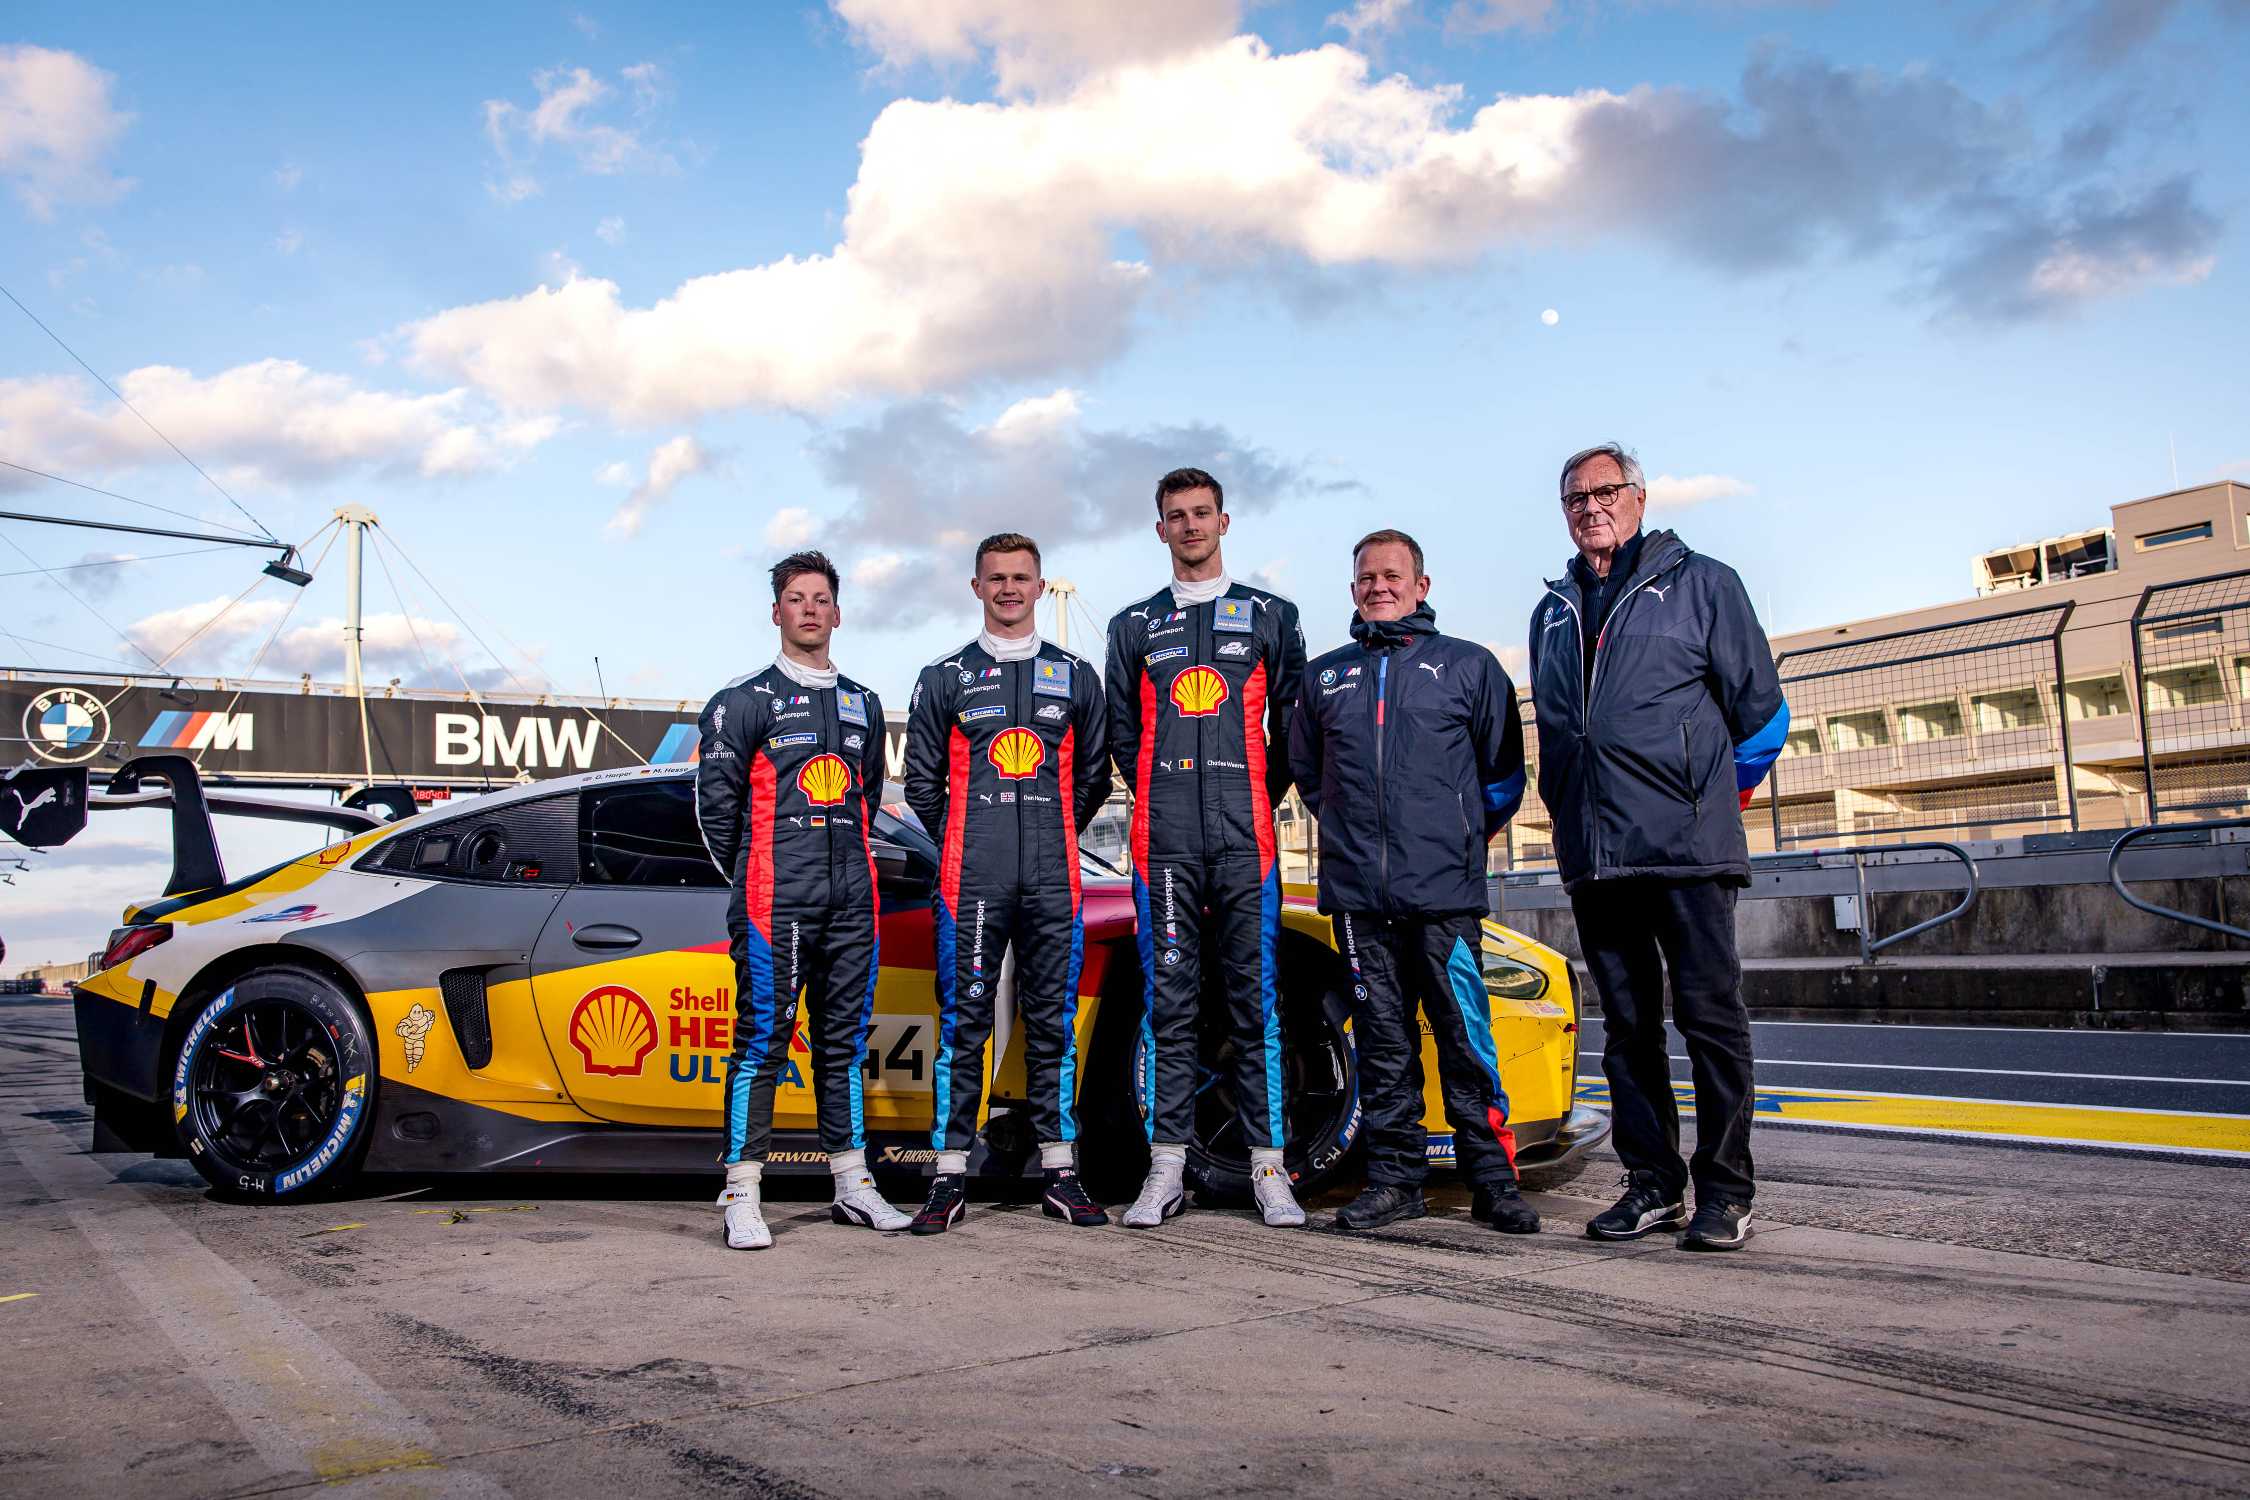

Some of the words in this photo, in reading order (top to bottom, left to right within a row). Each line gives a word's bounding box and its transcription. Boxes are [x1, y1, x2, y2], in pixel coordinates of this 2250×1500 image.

[1148, 626, 1185, 640] Motorsport
[963, 683, 1001, 696] Motorsport
[775, 711, 810, 722] Motorsport
[435, 713, 601, 768] BMW
[605, 771, 632, 779] Harper
[1164, 868, 1175, 920] Motorsport
[973, 900, 986, 954] Motorsport
[1344, 912, 1357, 955] Motorsp
[791, 921, 799, 975] Motorsport
[669, 987, 729, 1012] Shell
[176, 994, 228, 1083] MICHELIN
[668, 1015, 809, 1053] HEX
[669, 1053, 806, 1089] ULA
[282, 1112, 351, 1190] MICHELIN
[901, 1149, 940, 1163] AKRAP
[1425, 1145, 1455, 1156] MIC
